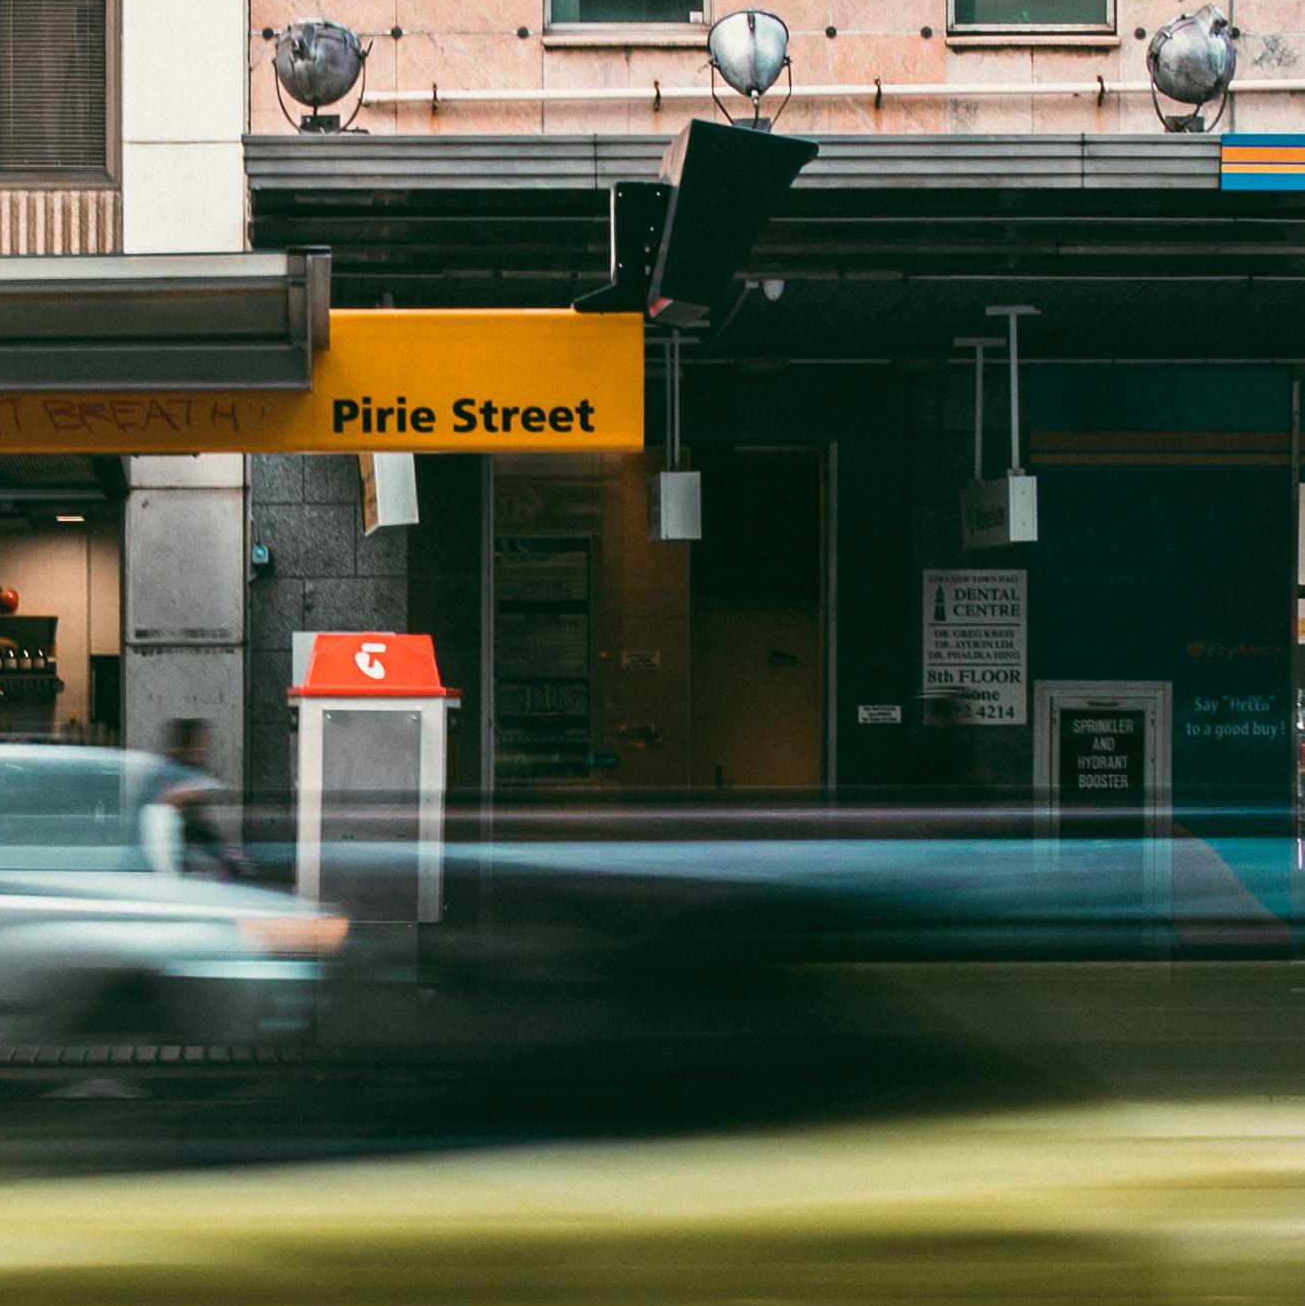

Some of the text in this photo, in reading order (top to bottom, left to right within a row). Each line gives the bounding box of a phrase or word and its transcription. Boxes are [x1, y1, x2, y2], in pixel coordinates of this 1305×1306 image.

[333, 397, 595, 433] Pirie Street
[955, 588, 1021, 601] DENTAL
[954, 604, 1021, 617] CENTRE
[953, 630, 982, 638] GREG
[927, 670, 1021, 683] 8th FLOOR
[977, 705, 1015, 718] 4214
[1194, 697, 1219, 715] Say
[1073, 719, 1134, 734] SPRINKLER
[1186, 722, 1201, 735] to
[1203, 724, 1212, 736] a
[1215, 721, 1249, 740] good
[1092, 737, 1115, 751] AND
[1077, 755, 1129, 769] HYDRANT
[1078, 774, 1129, 788] BOOSTER
